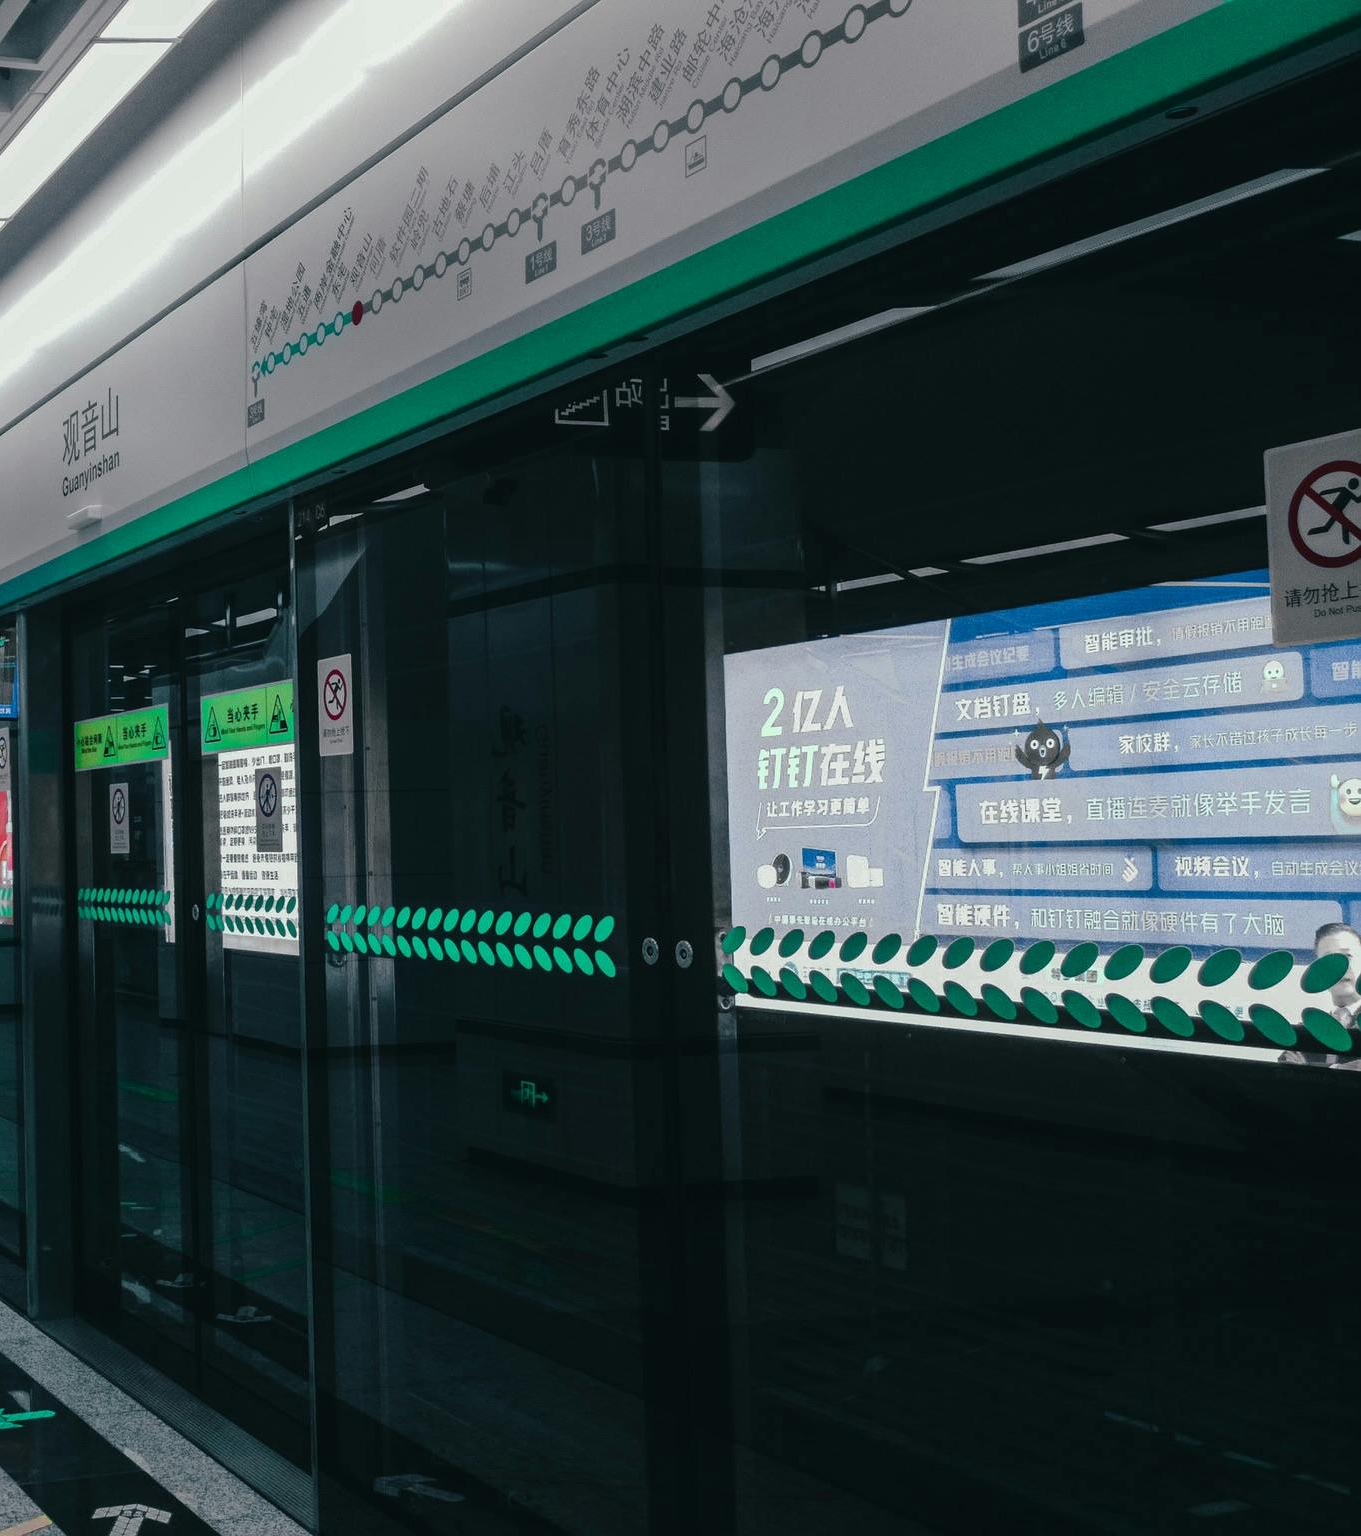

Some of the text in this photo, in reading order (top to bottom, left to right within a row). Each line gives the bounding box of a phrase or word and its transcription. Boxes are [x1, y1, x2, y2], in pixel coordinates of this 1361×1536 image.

[682, 0, 725, 82] 邮轮中
[1027, 13, 1074, 53] 6号线
[1039, 43, 1059, 60] Line
[62, 387, 119, 466] 观音山
[62, 451, 120, 497] Guanyinshan
[1284, 580, 1361, 608] 请勿抢上
[1314, 607, 1326, 618] Do
[1329, 605, 1343, 616] Not
[1142, 671, 1243, 701] 安全云存储
[227, 703, 259, 723] 当心夹手
[1190, 721, 1358, 749] 家长不错过孩子成长每一步
[757, 738, 886, 790] 钉钉在线
[766, 796, 871, 818] 让工作学习更简单
[1086, 788, 1312, 822] 直播连麦就像举手发言
[1271, 859, 1361, 877] 自动生成会议
[1030, 908, 1285, 936] 和钉钉融合就像硬件有了大脑
